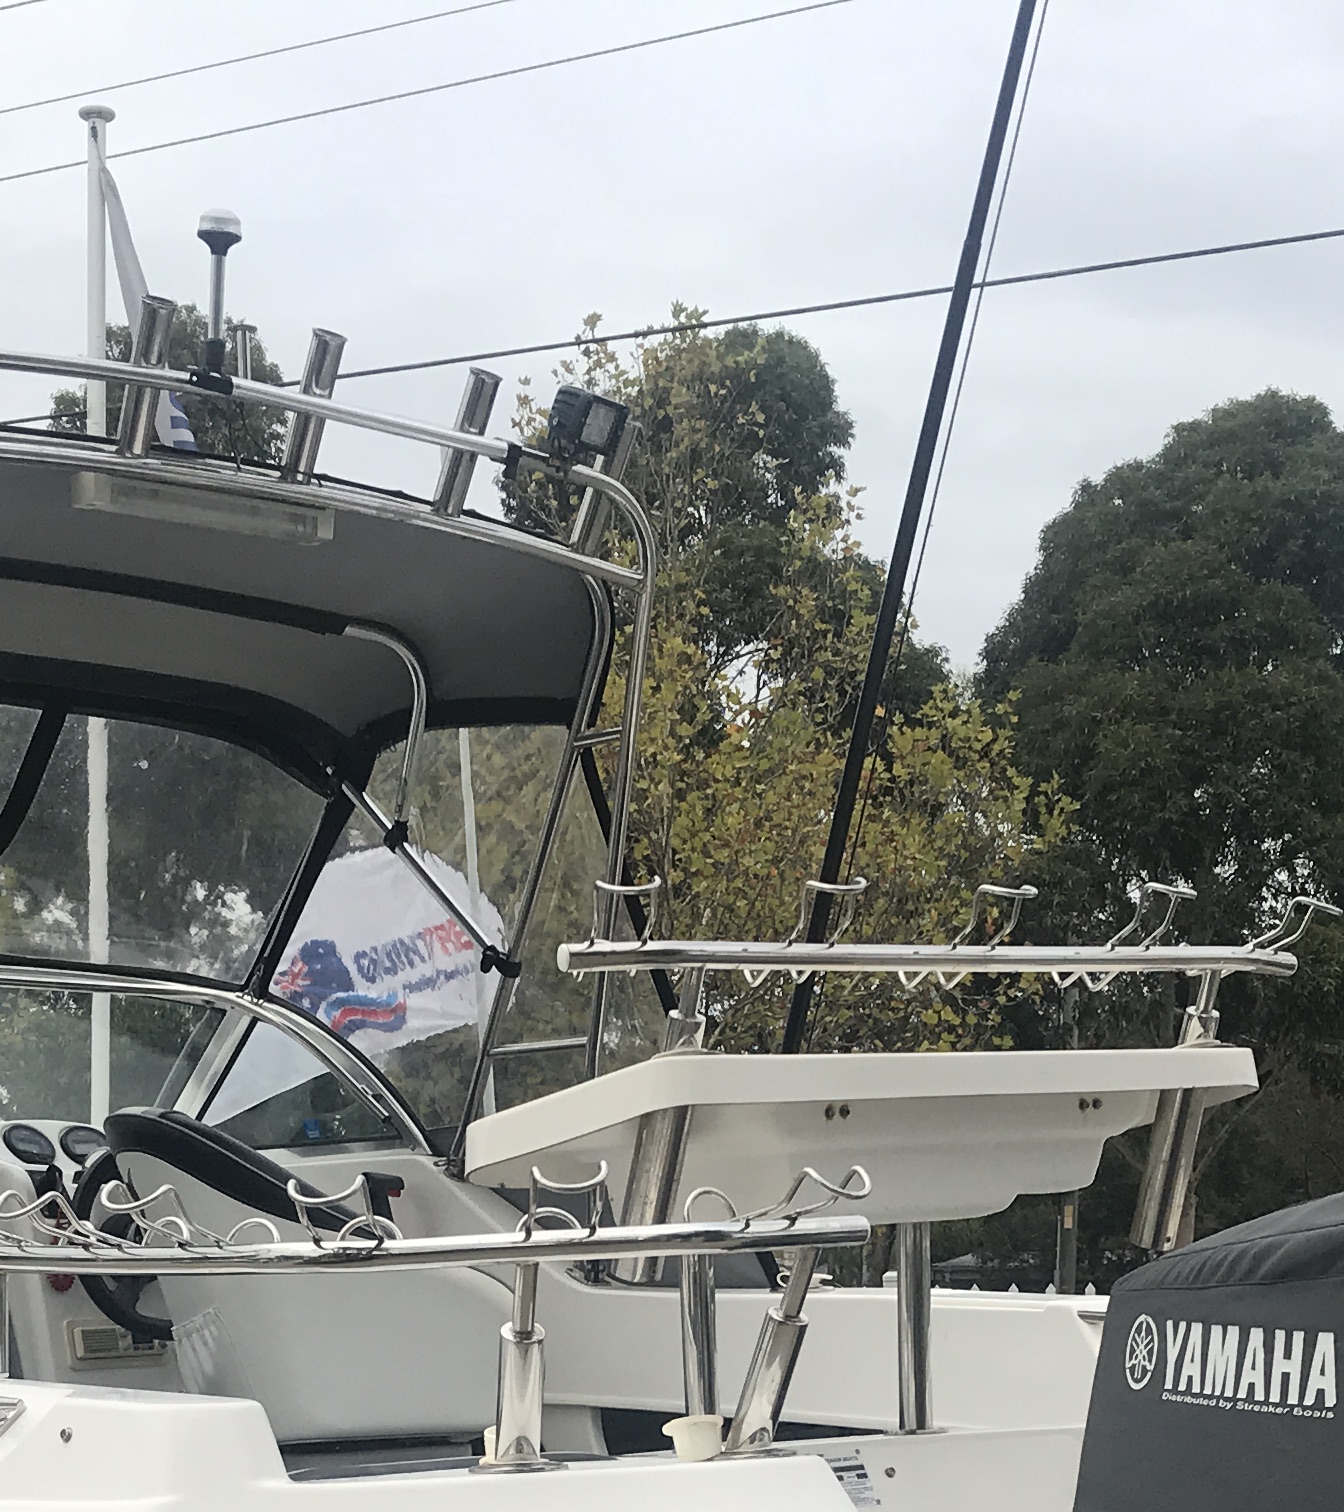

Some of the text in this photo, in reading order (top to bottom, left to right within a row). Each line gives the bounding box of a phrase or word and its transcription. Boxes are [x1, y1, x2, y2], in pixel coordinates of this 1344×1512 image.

[1164, 1319, 1337, 1408] YAMAHA
[1161, 1391, 1216, 1407] Distributed
[1219, 1399, 1234, 1410] by
[1236, 1400, 1290, 1415] Streaker
